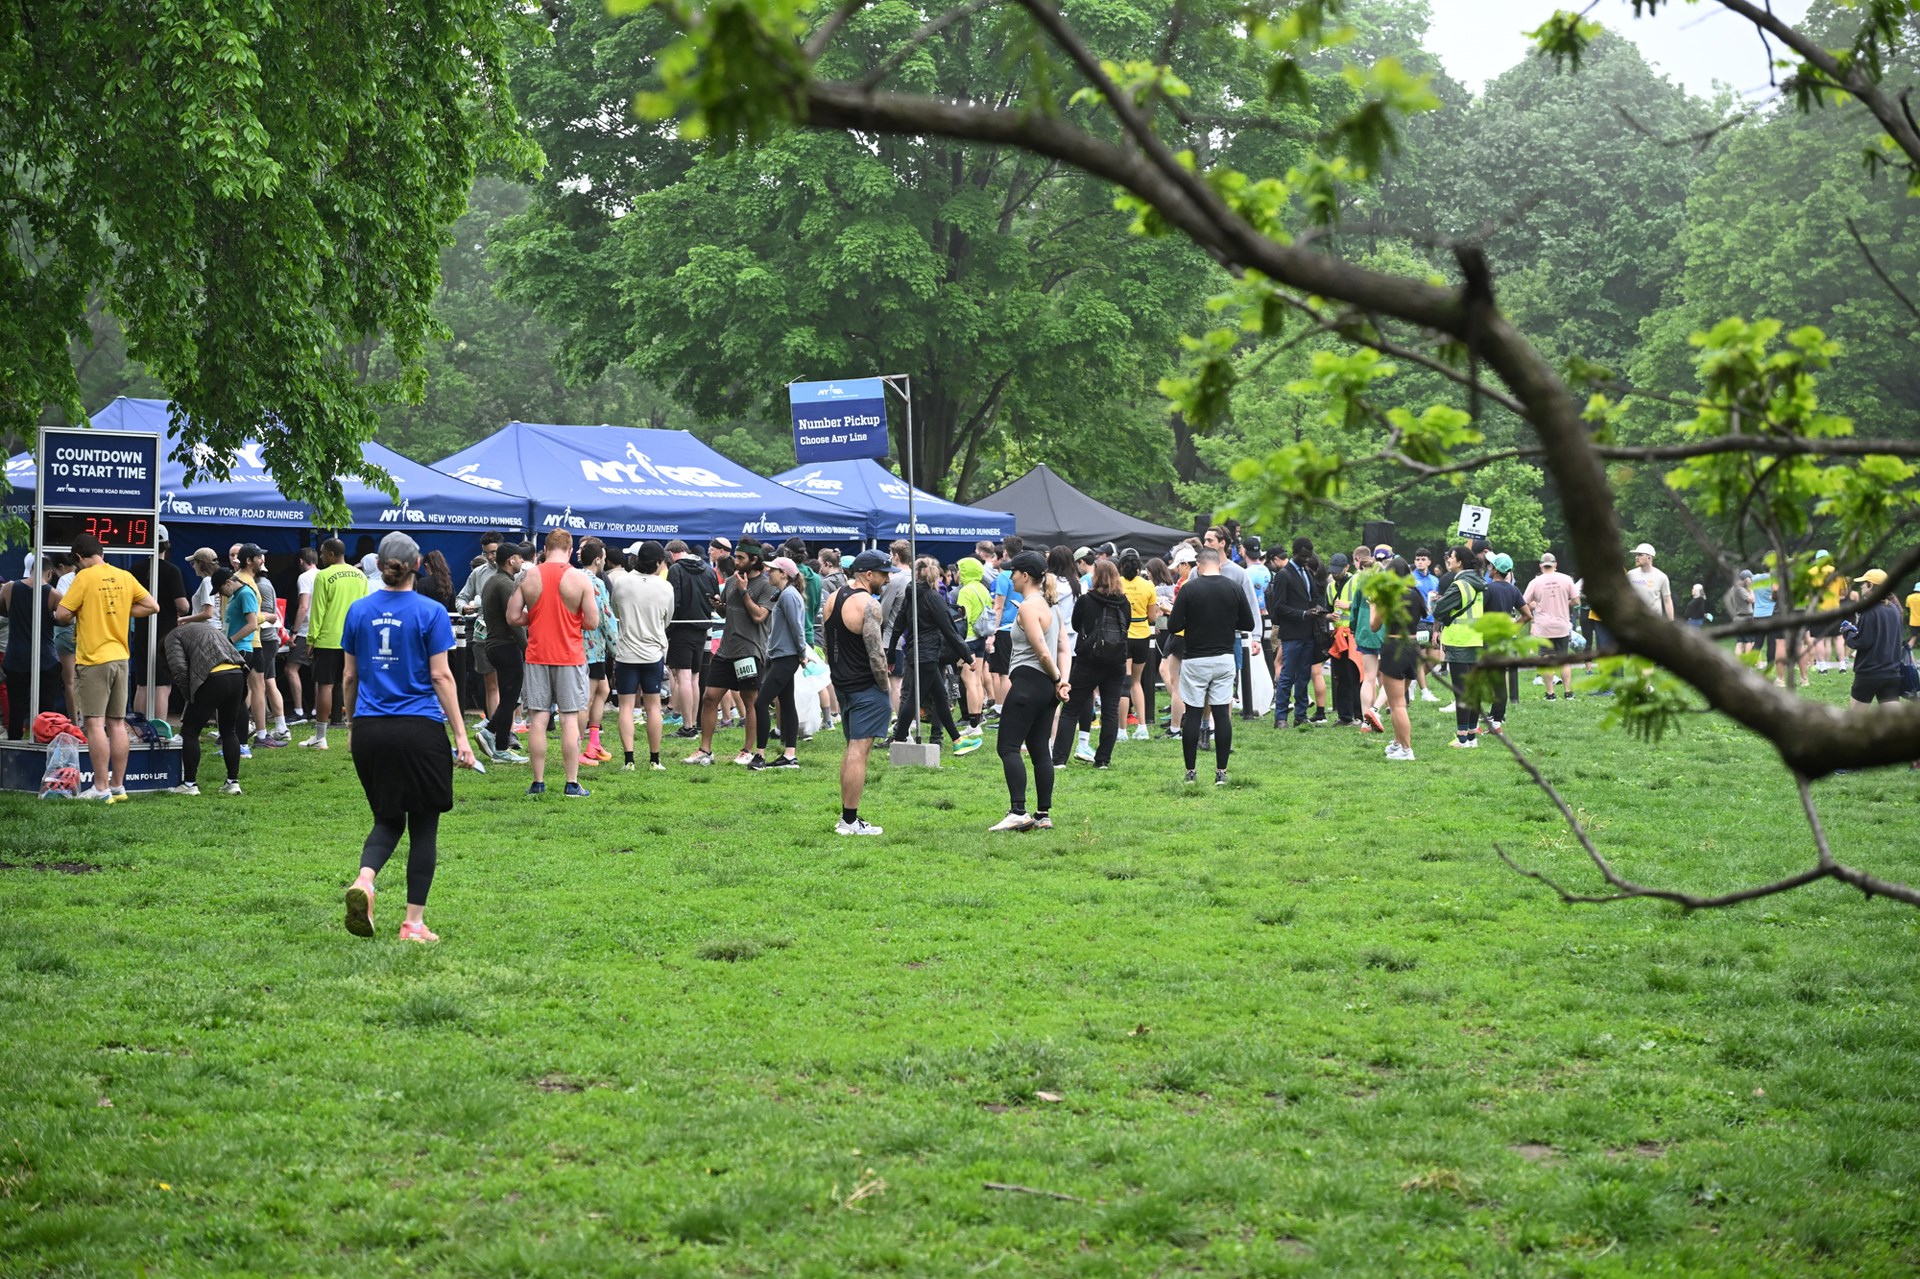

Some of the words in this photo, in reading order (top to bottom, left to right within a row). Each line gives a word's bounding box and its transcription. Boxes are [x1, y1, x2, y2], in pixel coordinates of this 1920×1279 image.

[798, 417, 842, 430] Number
[844, 415, 880, 427] Pickup
[800, 436, 830, 445] Choose
[831, 434, 848, 444] Any
[849, 432, 868, 442] Line
[56, 447, 142, 464] COUNTDOWN
[51, 463, 69, 476] TO
[72, 464, 113, 478] START
[116, 466, 147, 479] TIME
[580, 459, 744, 487] NYRR
[6, 505, 30, 514] YORK
[197, 506, 217, 515] NEW
[218, 507, 240, 517] YORK
[241, 508, 265, 519] ROAD
[266, 509, 304, 520] RUNNERS
[428, 514, 446, 523] NEW
[447, 514, 467, 524] YORK
[468, 516, 489, 525] ROAD
[490, 516, 523, 526] RUNNERS
[588, 521, 605, 530] NEW
[606, 522, 625, 531] YORK
[625, 523, 645, 532] ROAD
[646, 524, 679, 533] RUNNERS
[1472, 512, 1481, 528] ?
[783, 525, 797, 533] NEW
[798, 525, 815, 534] YORK
[815, 526, 833, 534] ROAD
[832, 526, 860, 534] RUNNERS
[931, 527, 945, 535] NEW
[945, 527, 960, 535] YORK
[960, 528, 976, 536] ROAD
[976, 528, 1001, 536] RUNNERS
[379, 627, 392, 655] 1
